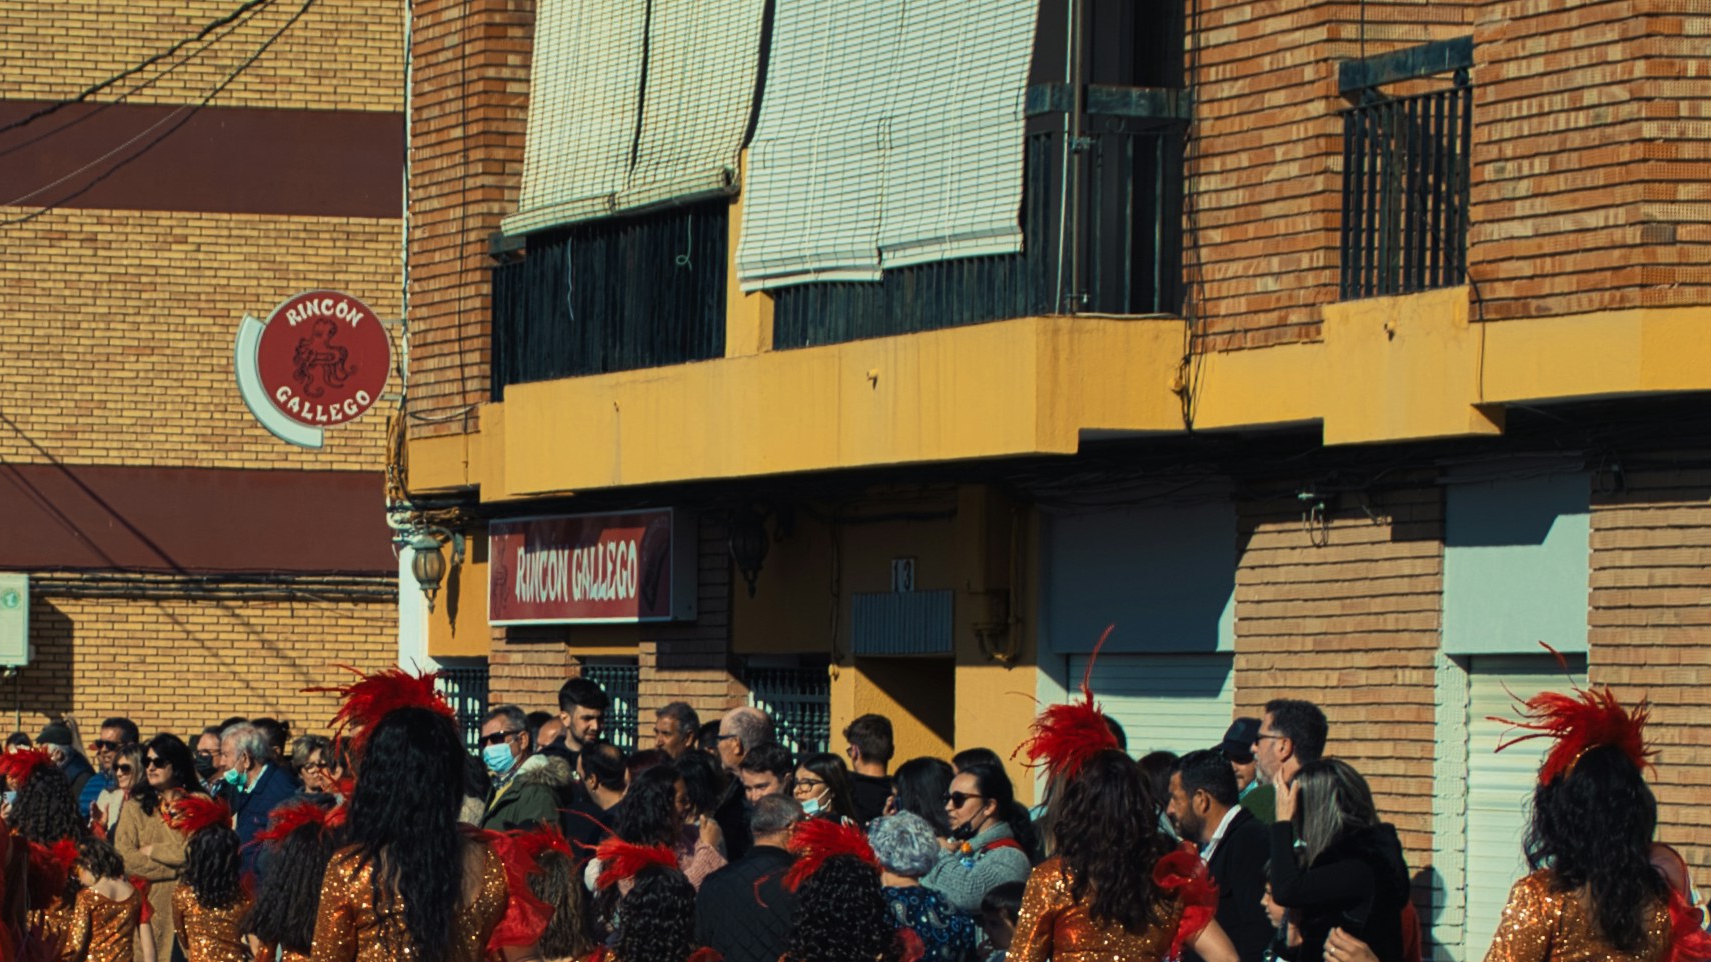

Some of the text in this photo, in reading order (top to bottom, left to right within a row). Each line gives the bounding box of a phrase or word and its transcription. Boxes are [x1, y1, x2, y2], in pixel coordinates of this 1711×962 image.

[285, 298, 364, 328] RINCÓN
[276, 386, 370, 421] GALLEGO
[572, 539, 638, 602] GALLEGO
[894, 560, 912, 591] 13
